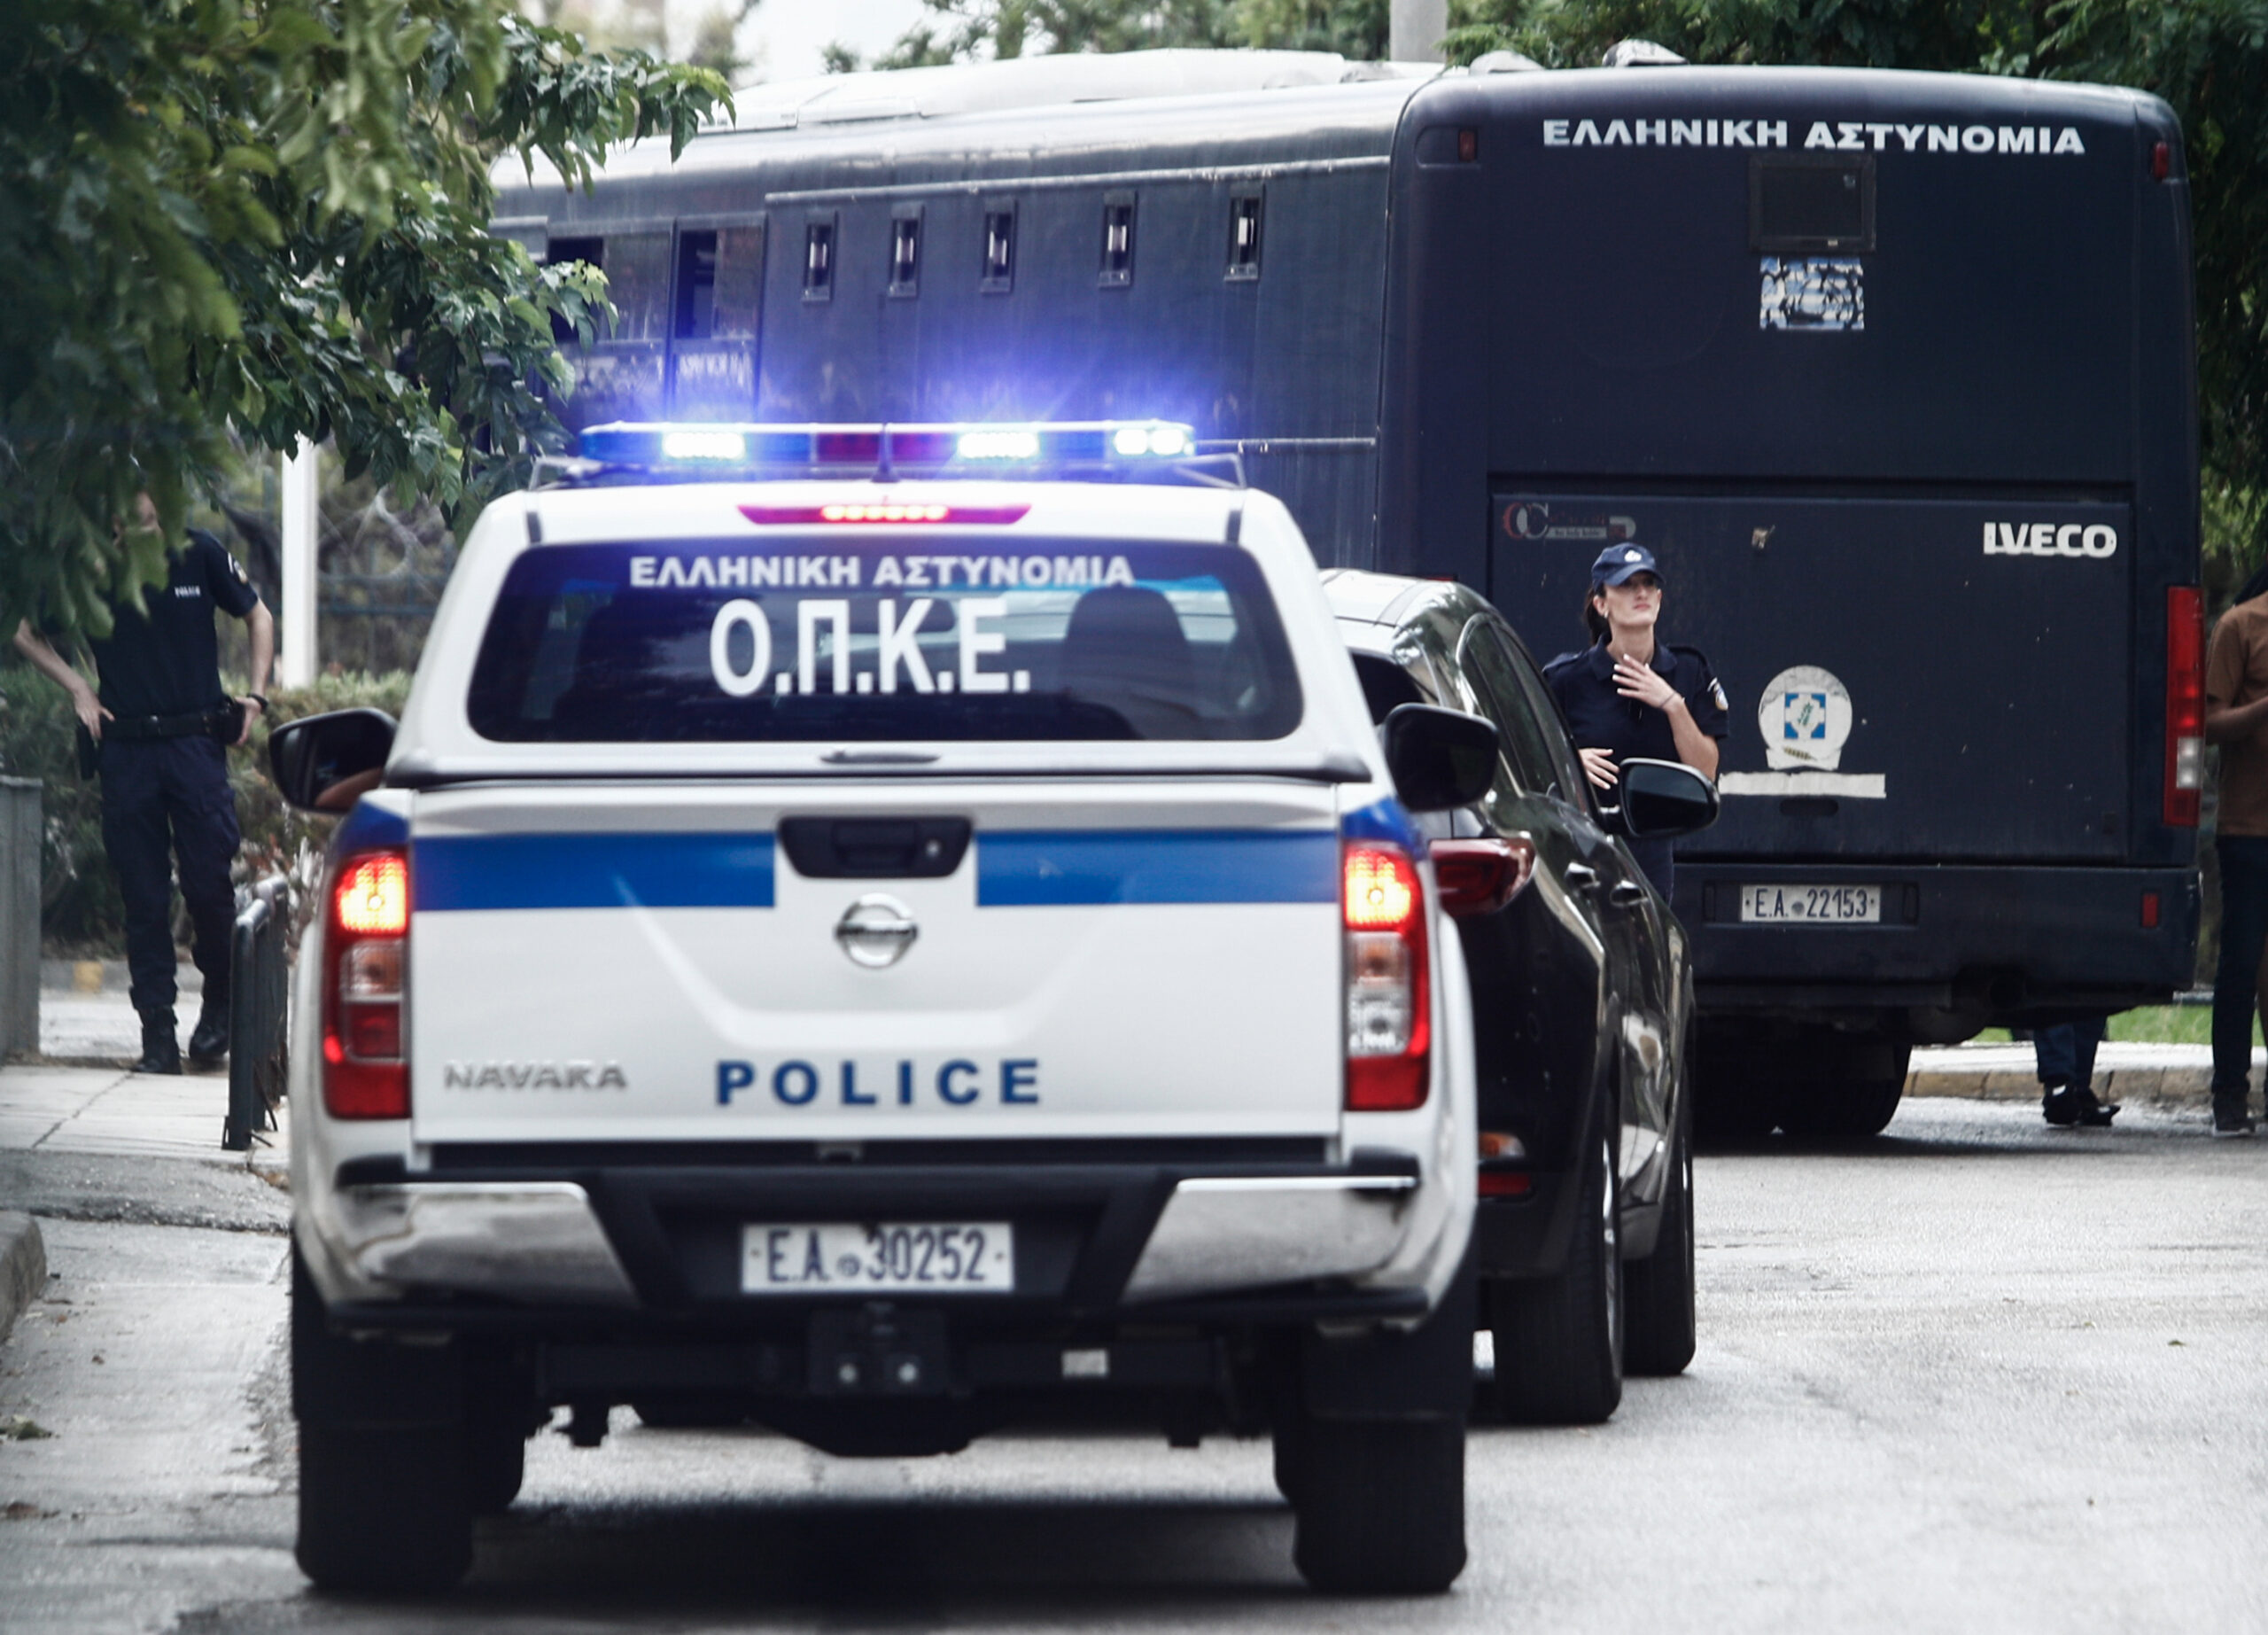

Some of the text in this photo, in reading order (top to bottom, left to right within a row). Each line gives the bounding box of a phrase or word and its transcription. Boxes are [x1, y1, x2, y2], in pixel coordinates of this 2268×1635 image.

[1543, 119, 2085, 154] ΕΛΛΗΝΙΚΗ ΑΣΤΥΝΟΜΙΑ
[1983, 522, 2117, 558] IVECO
[630, 556, 1135, 587] ΕΛΛΗΝΙΚΗ ΑΣΤΥΝΟΜΙΑ
[710, 599, 1030, 697] Ο.Π.Κ.Ε.
[1806, 888, 1868, 918] 22153
[715, 1059, 1040, 1108] POLICE
[866, 1228, 986, 1281] 30252
